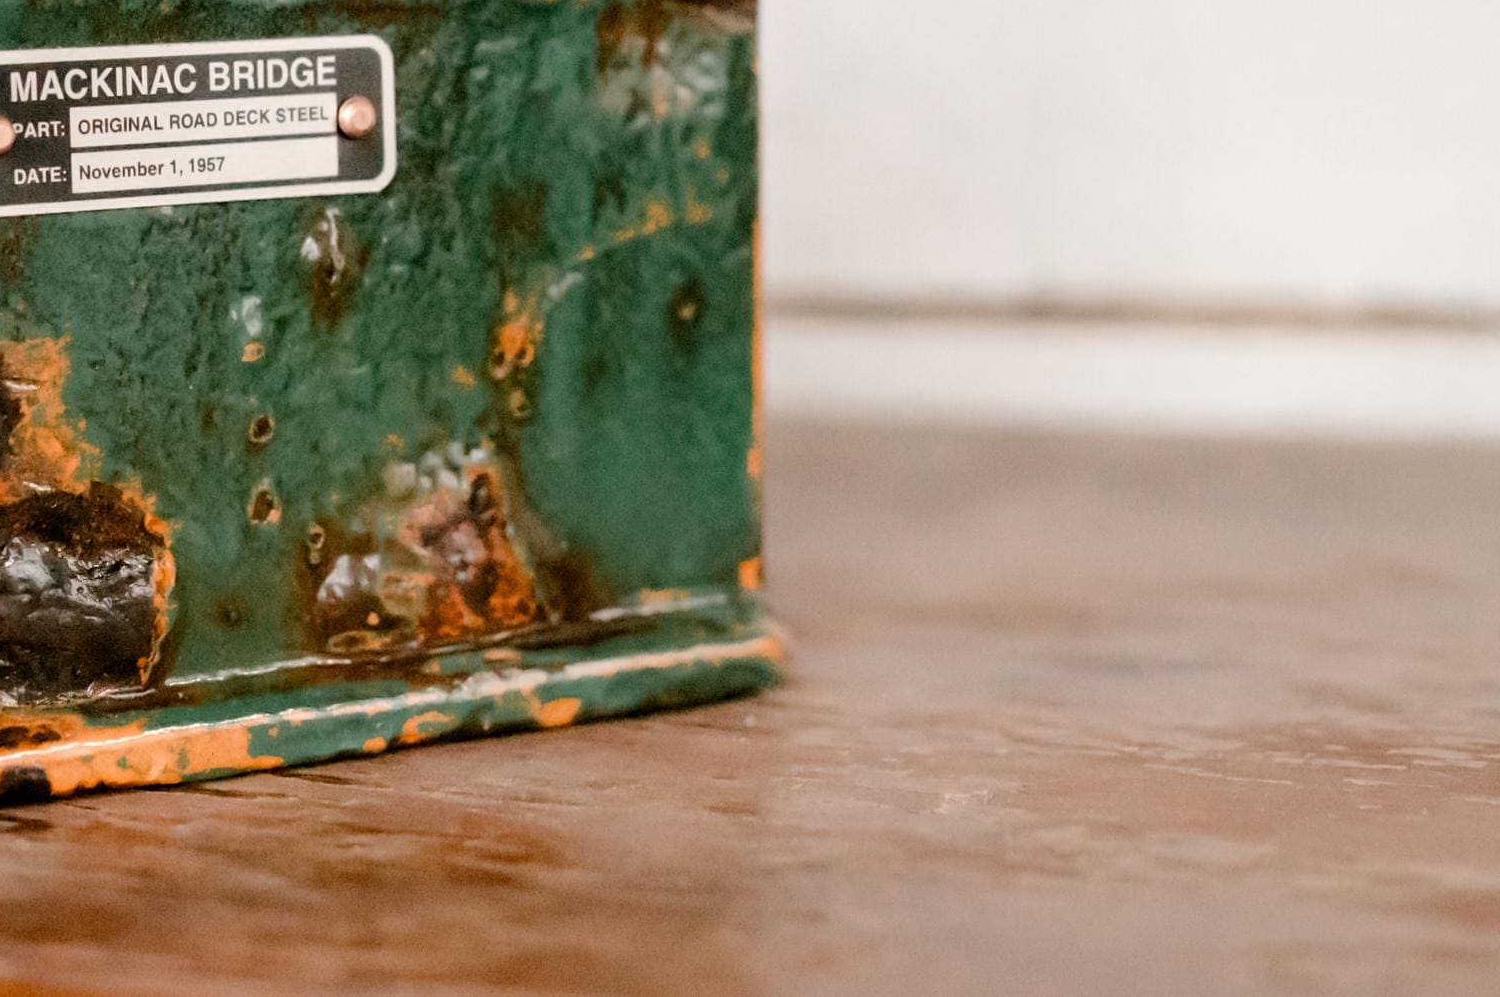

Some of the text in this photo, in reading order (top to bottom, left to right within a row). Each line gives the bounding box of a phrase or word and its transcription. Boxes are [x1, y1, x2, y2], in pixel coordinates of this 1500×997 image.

[10, 55, 337, 102] MACKINAC BRIDGE
[13, 106, 329, 139] PART: ORIGINAL ROAD DECK STEEL
[13, 156, 225, 186] DATE: November 1, 1957
